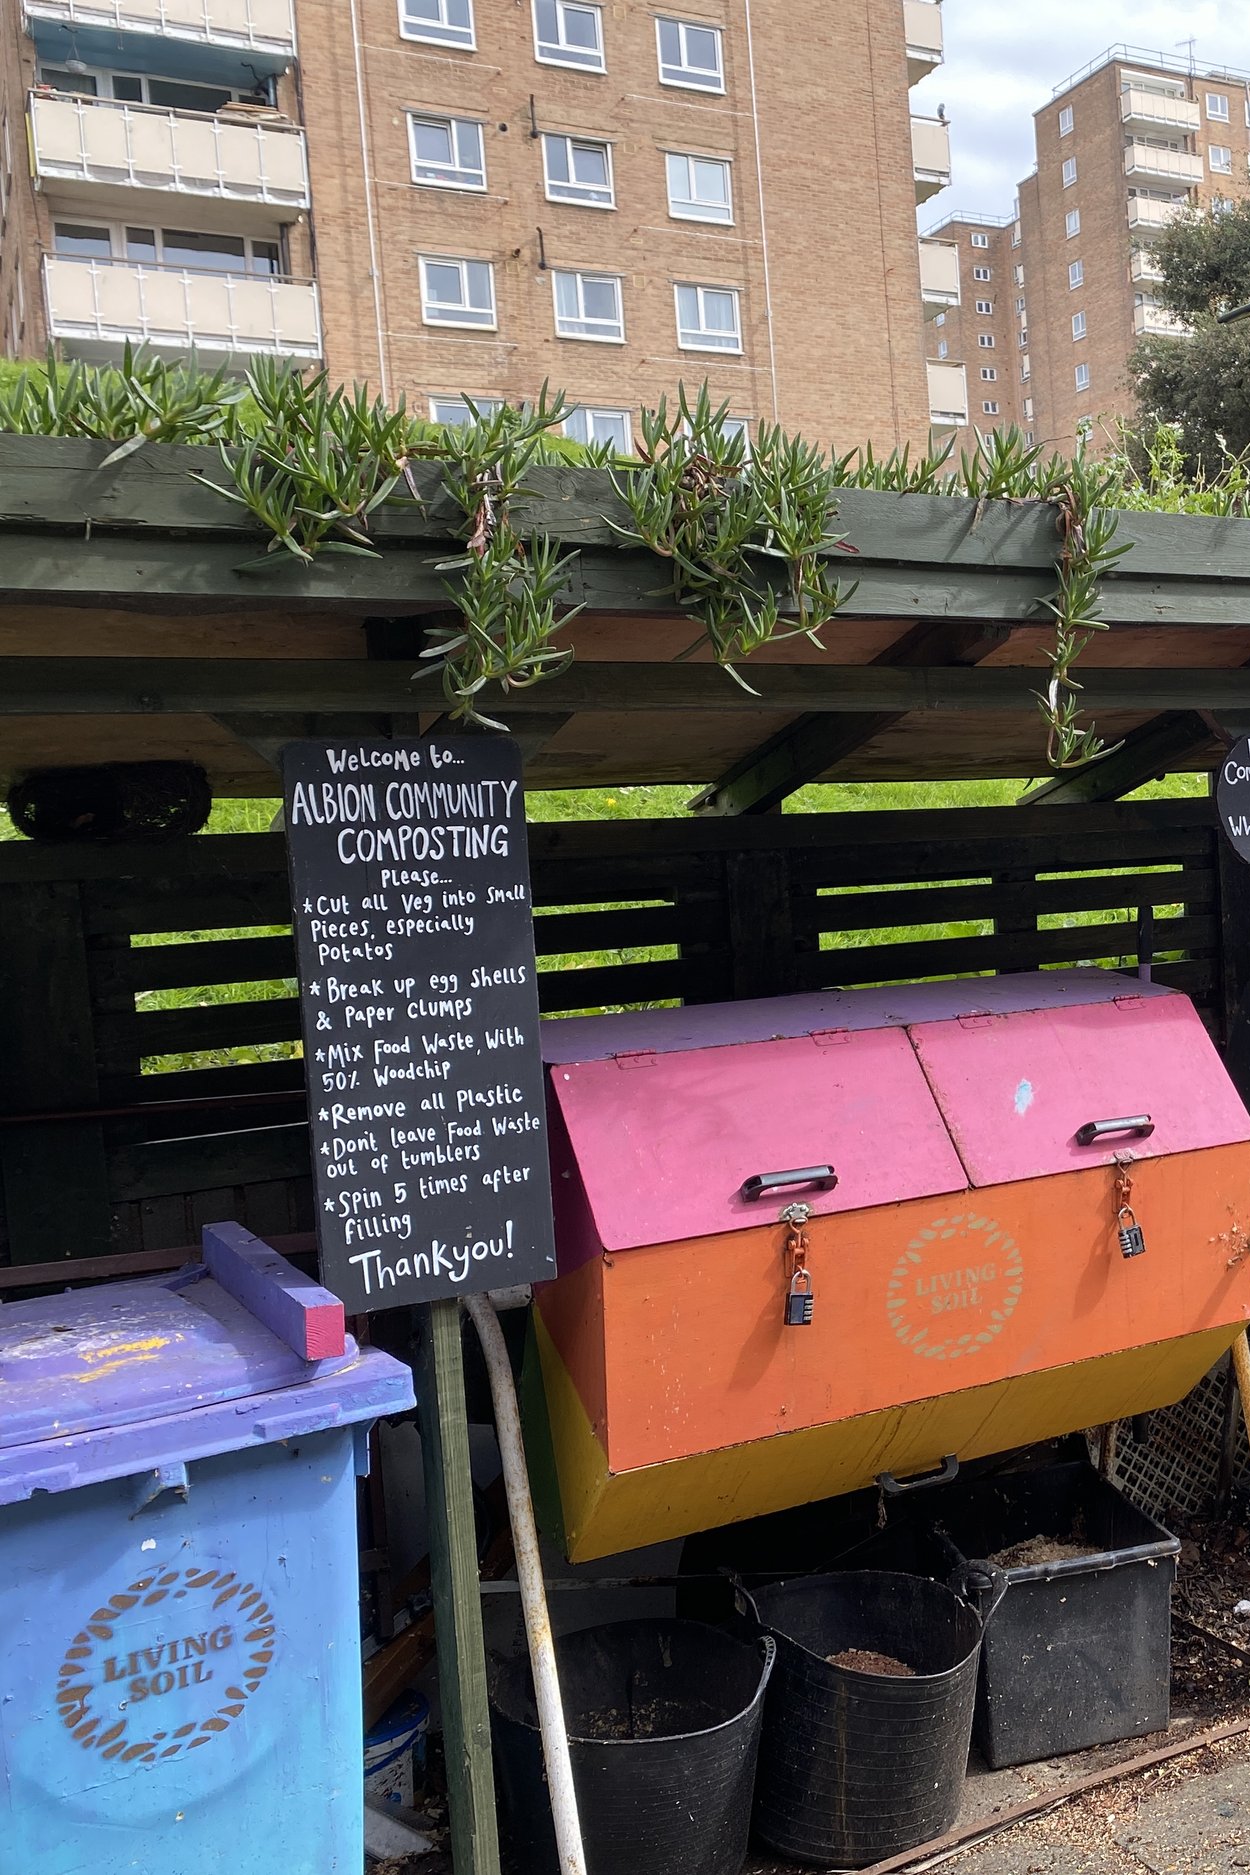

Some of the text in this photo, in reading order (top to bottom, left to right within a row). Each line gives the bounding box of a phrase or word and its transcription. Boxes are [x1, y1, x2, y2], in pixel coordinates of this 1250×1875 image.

[326, 748, 420, 773] Welcome
[292, 780, 517, 825] ALBION COMMUNITY
[337, 825, 509, 864] COMPOSTING
[362, 894, 388, 911] all
[401, 894, 432, 913] Veg
[443, 891, 475, 908] into
[487, 885, 525, 904] Small
[387, 915, 473, 937] especially
[319, 942, 393, 965] Potatos
[430, 974, 458, 993] egg
[316, 1011, 332, 1031] &
[374, 1036, 410, 1064] Food
[322, 1060, 451, 1092] 50% Woodchip
[421, 1093, 445, 1110] all
[457, 1084, 523, 1112] Plastic
[391, 1127, 435, 1149] leave
[448, 1120, 482, 1143] Food
[492, 1112, 540, 1136] Waste
[327, 1143, 480, 1178] out of tumblers
[395, 1183, 407, 1204] 5
[420, 1173, 468, 1199] times
[482, 1165, 530, 1193] after
[345, 1213, 412, 1245] filling
[916, 1263, 995, 1296] LIVING
[932, 1288, 982, 1315] SOIL
[103, 1625, 233, 1683] LIVING
[129, 1661, 213, 1702] SOIL
